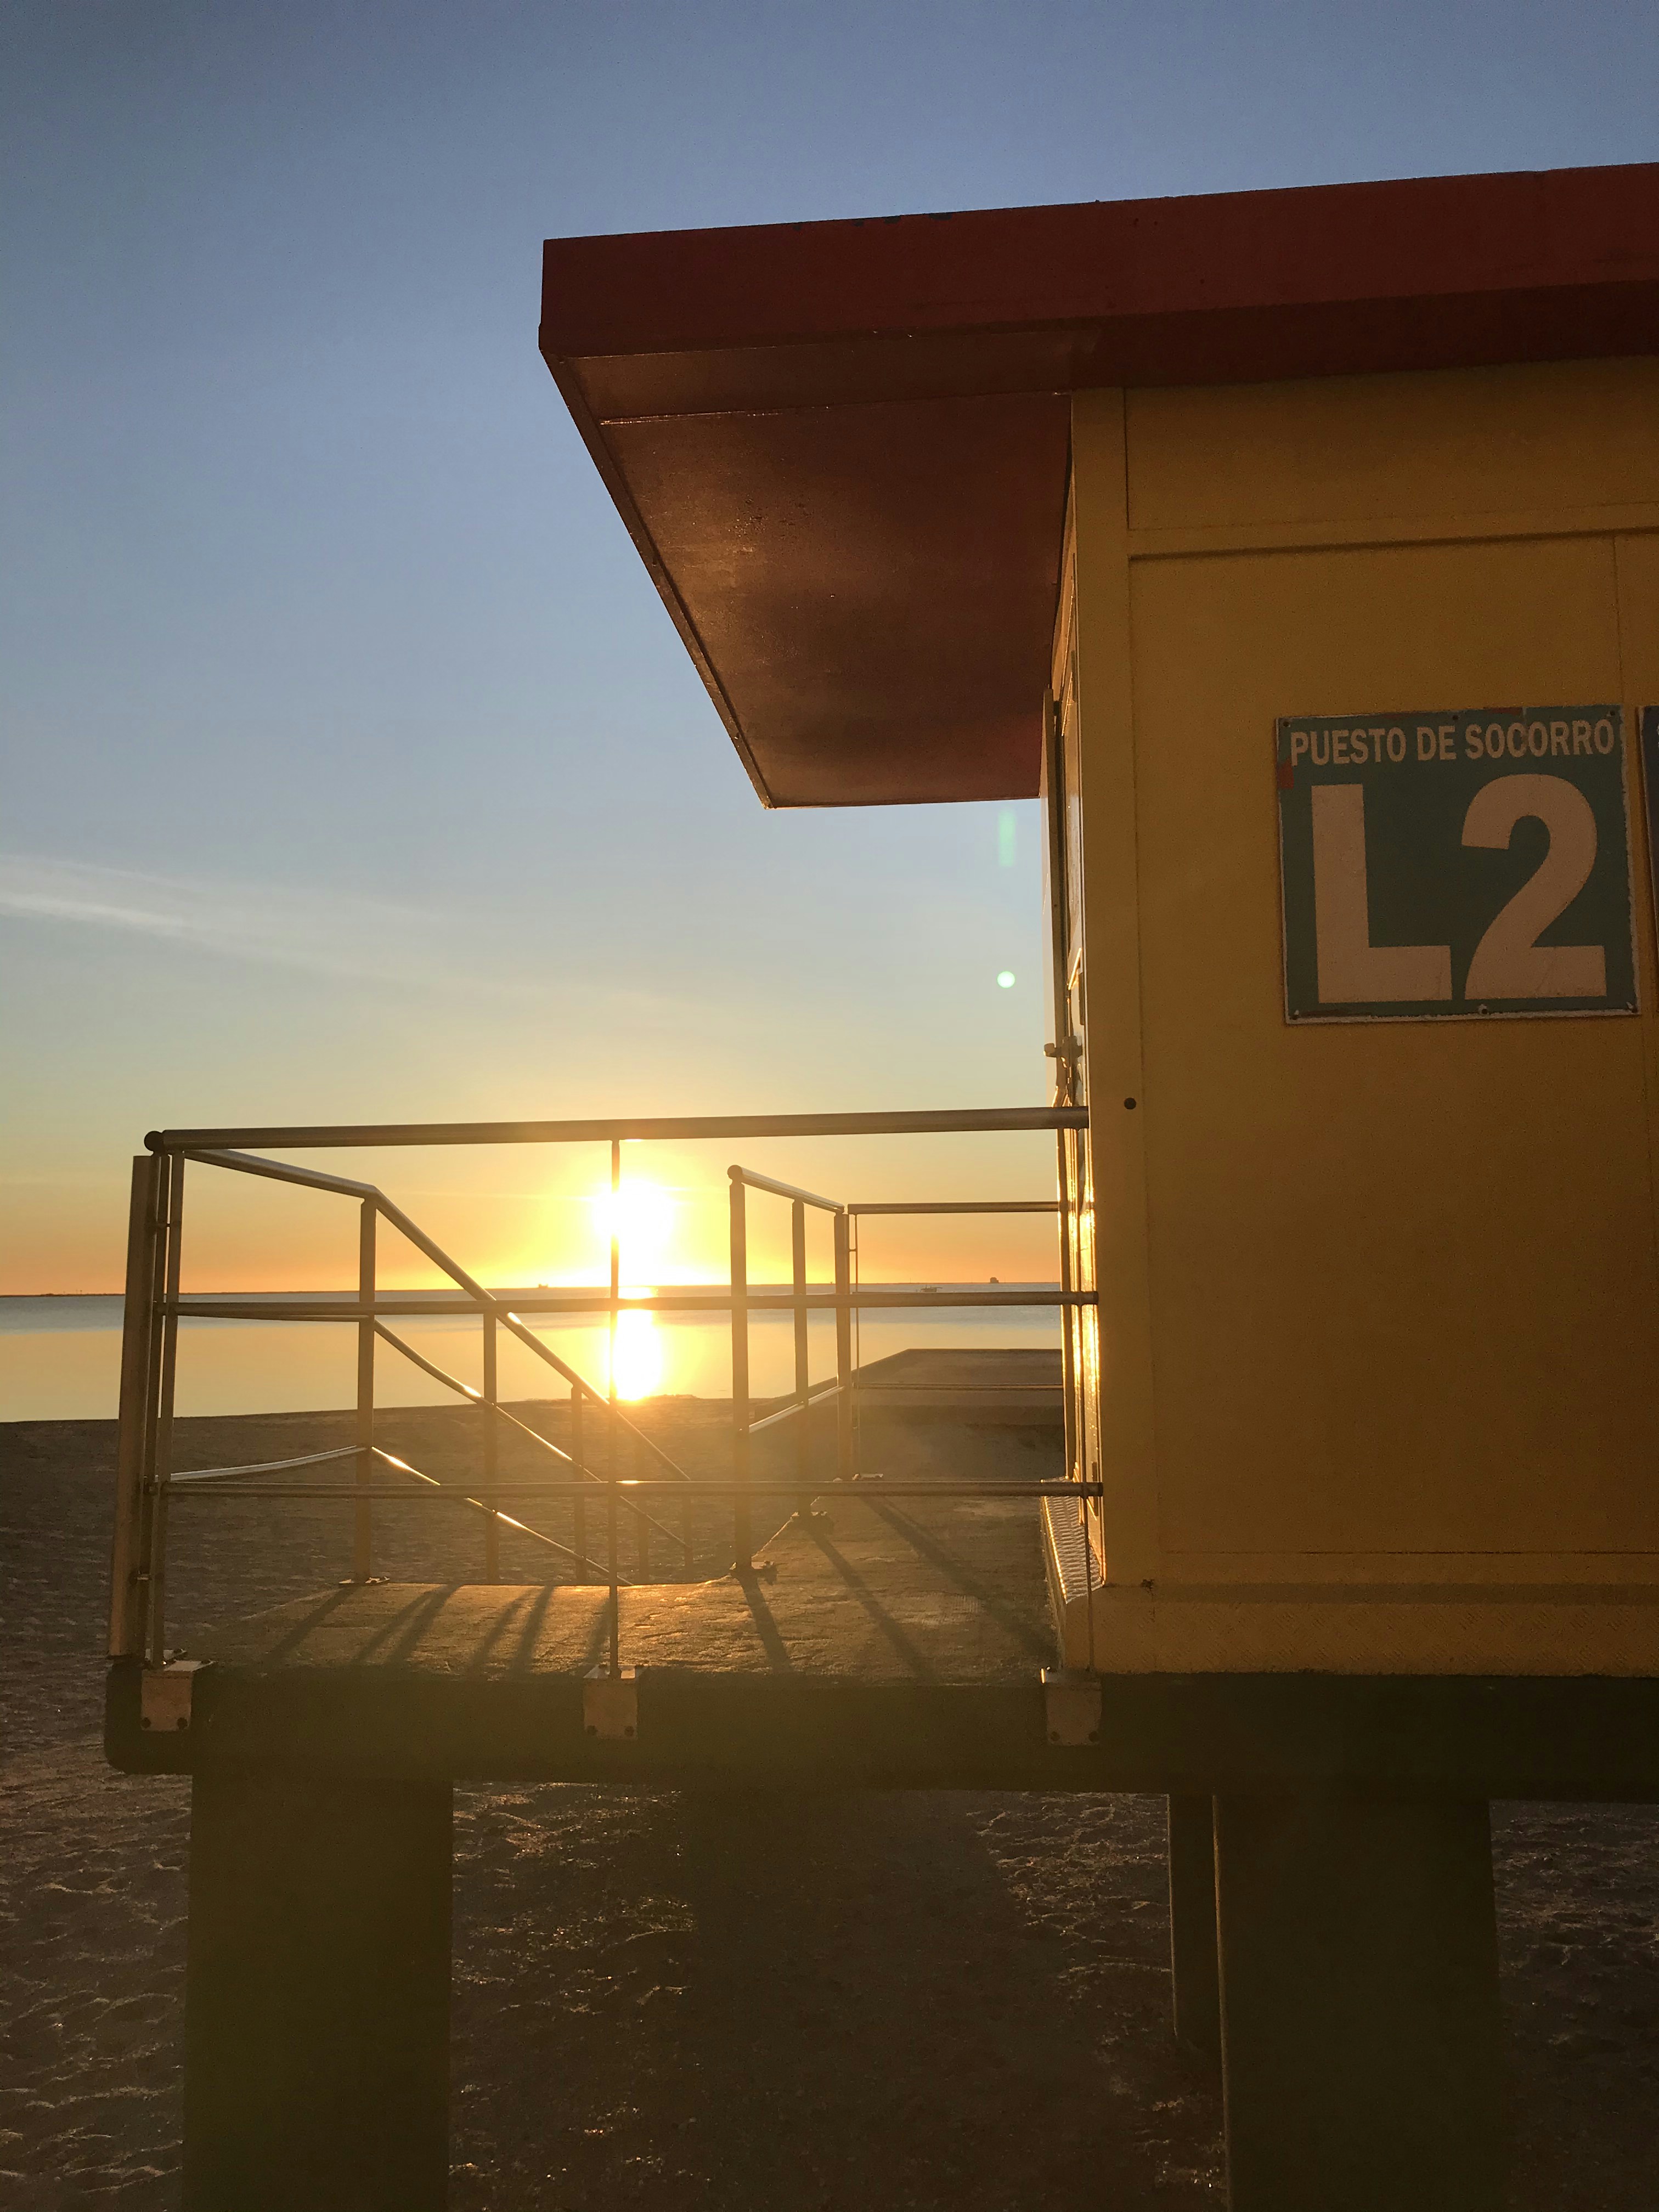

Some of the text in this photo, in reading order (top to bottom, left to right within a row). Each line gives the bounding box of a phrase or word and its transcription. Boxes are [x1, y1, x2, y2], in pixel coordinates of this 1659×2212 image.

[1290, 727, 1407, 766] PUESTO
[1417, 725, 1457, 761] DE
[1465, 719, 1615, 760] SOCORRO
[1311, 774, 1607, 1003] L2
